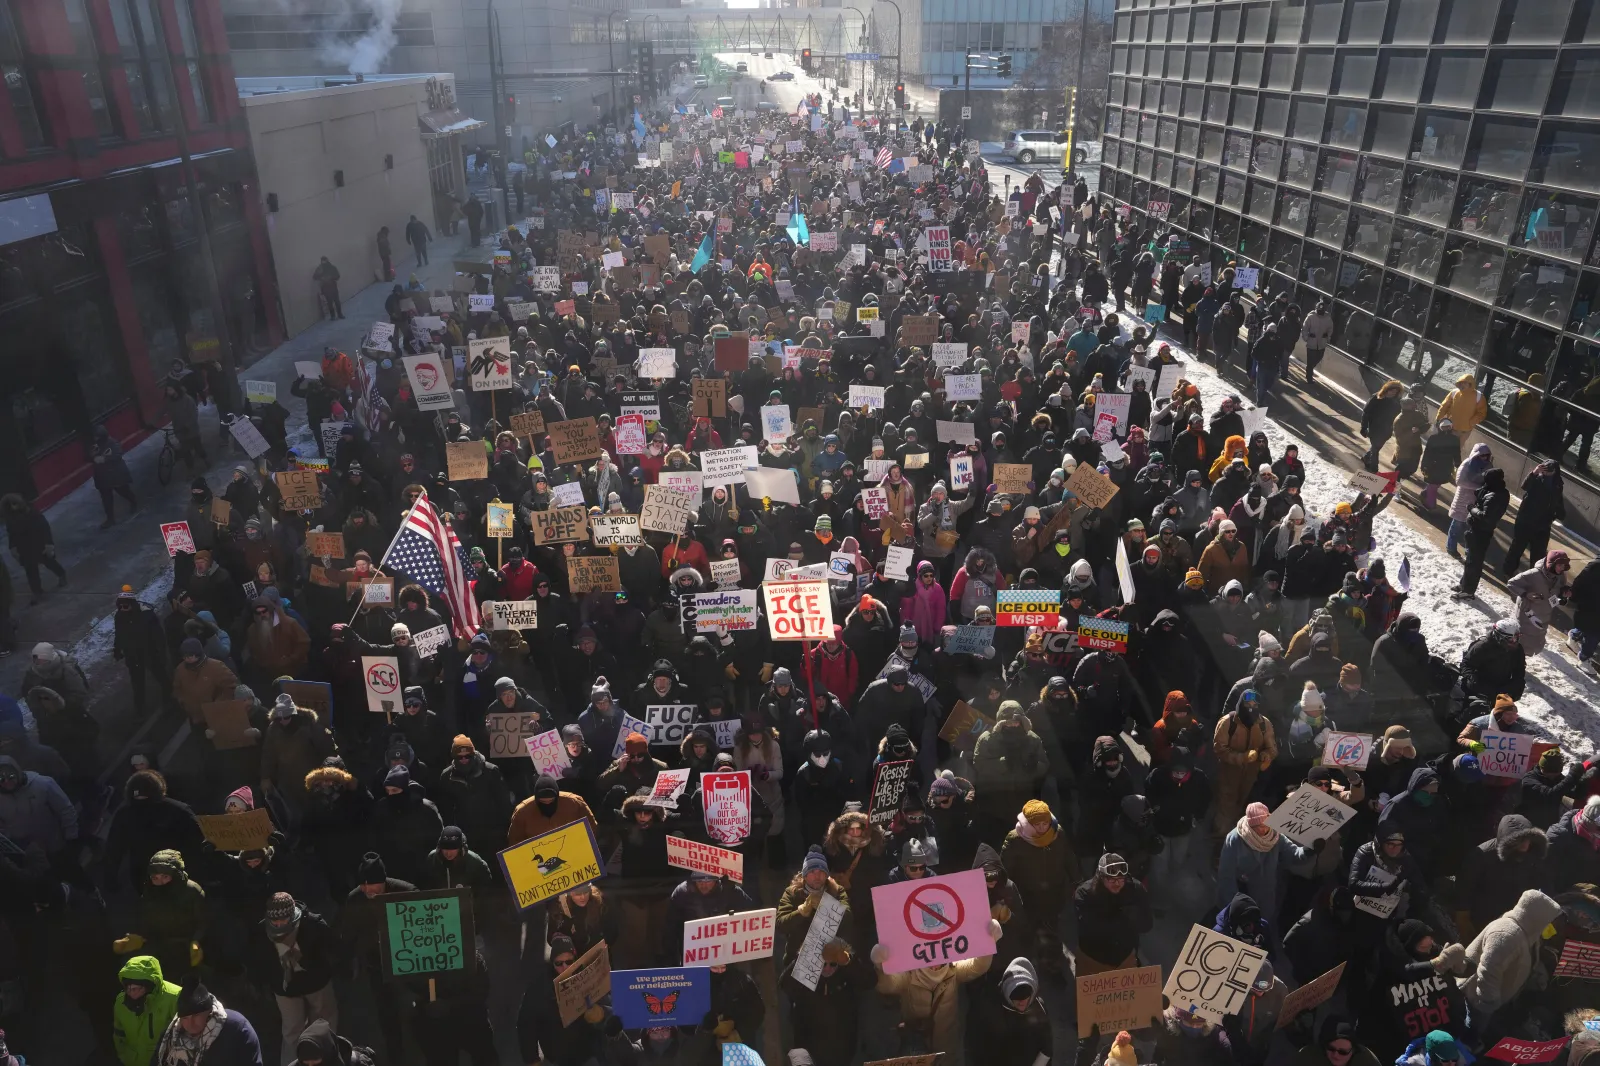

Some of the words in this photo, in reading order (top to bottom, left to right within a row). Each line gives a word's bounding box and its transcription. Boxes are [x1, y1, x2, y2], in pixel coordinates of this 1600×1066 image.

[928, 229, 949, 241] NO
[930, 248, 950, 260] NO
[931, 260, 950, 270] ICE
[492, 378, 510, 386] MN
[697, 380, 720, 388] ICE
[417, 394, 451, 403] COWARDICE
[696, 389, 721, 399] OUT
[513, 411, 541, 425] STOP
[511, 420, 542, 432] KILLING
[554, 423, 571, 431] What
[564, 429, 585, 440] YOU
[705, 449, 743, 458] OPERATION
[706, 457, 728, 465] METRO
[719, 463, 743, 471] SAFETY
[956, 462, 968, 472] MN
[1080, 465, 1099, 480] MORE
[283, 472, 313, 486] ICE
[647, 491, 691, 511] POLICE
[1072, 482, 1102, 507] THUGS
[644, 504, 690, 524] STATE
[867, 504, 884, 512] FUCK
[537, 508, 583, 527] HANDS
[592, 517, 607, 526] THE
[608, 516, 637, 526] WORLD
[543, 524, 577, 540] OFF
[595, 535, 643, 545] WATCHING
[569, 559, 583, 568] THE
[576, 567, 590, 577] MEN
[590, 567, 606, 575] WHO
[592, 575, 613, 584] LIVED
[810, 569, 823, 577] FOR
[769, 586, 807, 595] NEIGHBORS
[494, 603, 514, 611] SAY
[771, 594, 821, 615] ICE
[999, 603, 1024, 612] ICE
[1026, 603, 1060, 612] OUT
[775, 616, 826, 635] OUT!
[1011, 614, 1045, 624] MSP
[415, 632, 433, 642] THIS
[435, 627, 445, 635] IS
[1079, 629, 1096, 638] ICE
[1096, 631, 1127, 642] OUT
[1043, 632, 1078, 653] ICE
[1089, 638, 1116, 649] MSP
[371, 669, 397, 687] ICE
[491, 716, 531, 733] ICE
[622, 716, 651, 738] ICE
[528, 731, 559, 750] ICE
[1483, 735, 1516, 751] ICE
[532, 743, 560, 761] OUT
[1336, 743, 1362, 760] ICE
[1495, 750, 1528, 765] OUT
[542, 753, 559, 767] OF
[879, 762, 910, 781] Resist
[875, 779, 892, 797] Like
[720, 801, 737, 810] I.C.E.
[877, 790, 899, 806] 1938
[1294, 791, 1331, 812] PLOW
[708, 815, 748, 827] MINNEAPOLIS
[717, 810, 730, 818] OUT
[731, 809, 739, 817] OF
[1288, 806, 1307, 821] ICE
[1310, 817, 1335, 830] OUT
[1279, 819, 1311, 836] MN
[667, 836, 740, 864] SUPPORT
[688, 850, 720, 865] OUR
[667, 855, 743, 881] NEIGHBORS
[541, 875, 571, 896] TREAD
[572, 871, 585, 886] ON
[585, 862, 600, 878] ME
[395, 902, 416, 917] Do
[423, 901, 449, 917] you
[403, 914, 444, 928] Hear
[691, 915, 773, 941] JUSTICE
[822, 903, 845, 940] FREE
[420, 925, 435, 933] the
[400, 924, 456, 951] People
[685, 944, 721, 964] NOT
[731, 936, 773, 956] LIES
[912, 935, 969, 964] GTFO
[394, 945, 460, 974] Sing?
[1184, 930, 1264, 990] ICE
[646, 981, 693, 991] neighbors
[651, 974, 685, 984] protect
[1082, 975, 1118, 993] SHAME
[1120, 974, 1136, 987] ON
[1138, 972, 1158, 985] YOU
[1172, 988, 1194, 1004] for
[1176, 968, 1247, 1009] OUT
[1391, 976, 1448, 1006] MAKE
[1417, 993, 1430, 1008] IT
[1404, 996, 1451, 1037] STOP
[1098, 1017, 1138, 1032] EGSETH
[1499, 1042, 1564, 1054] ABOLISH
[1514, 1052, 1541, 1061] ICE
